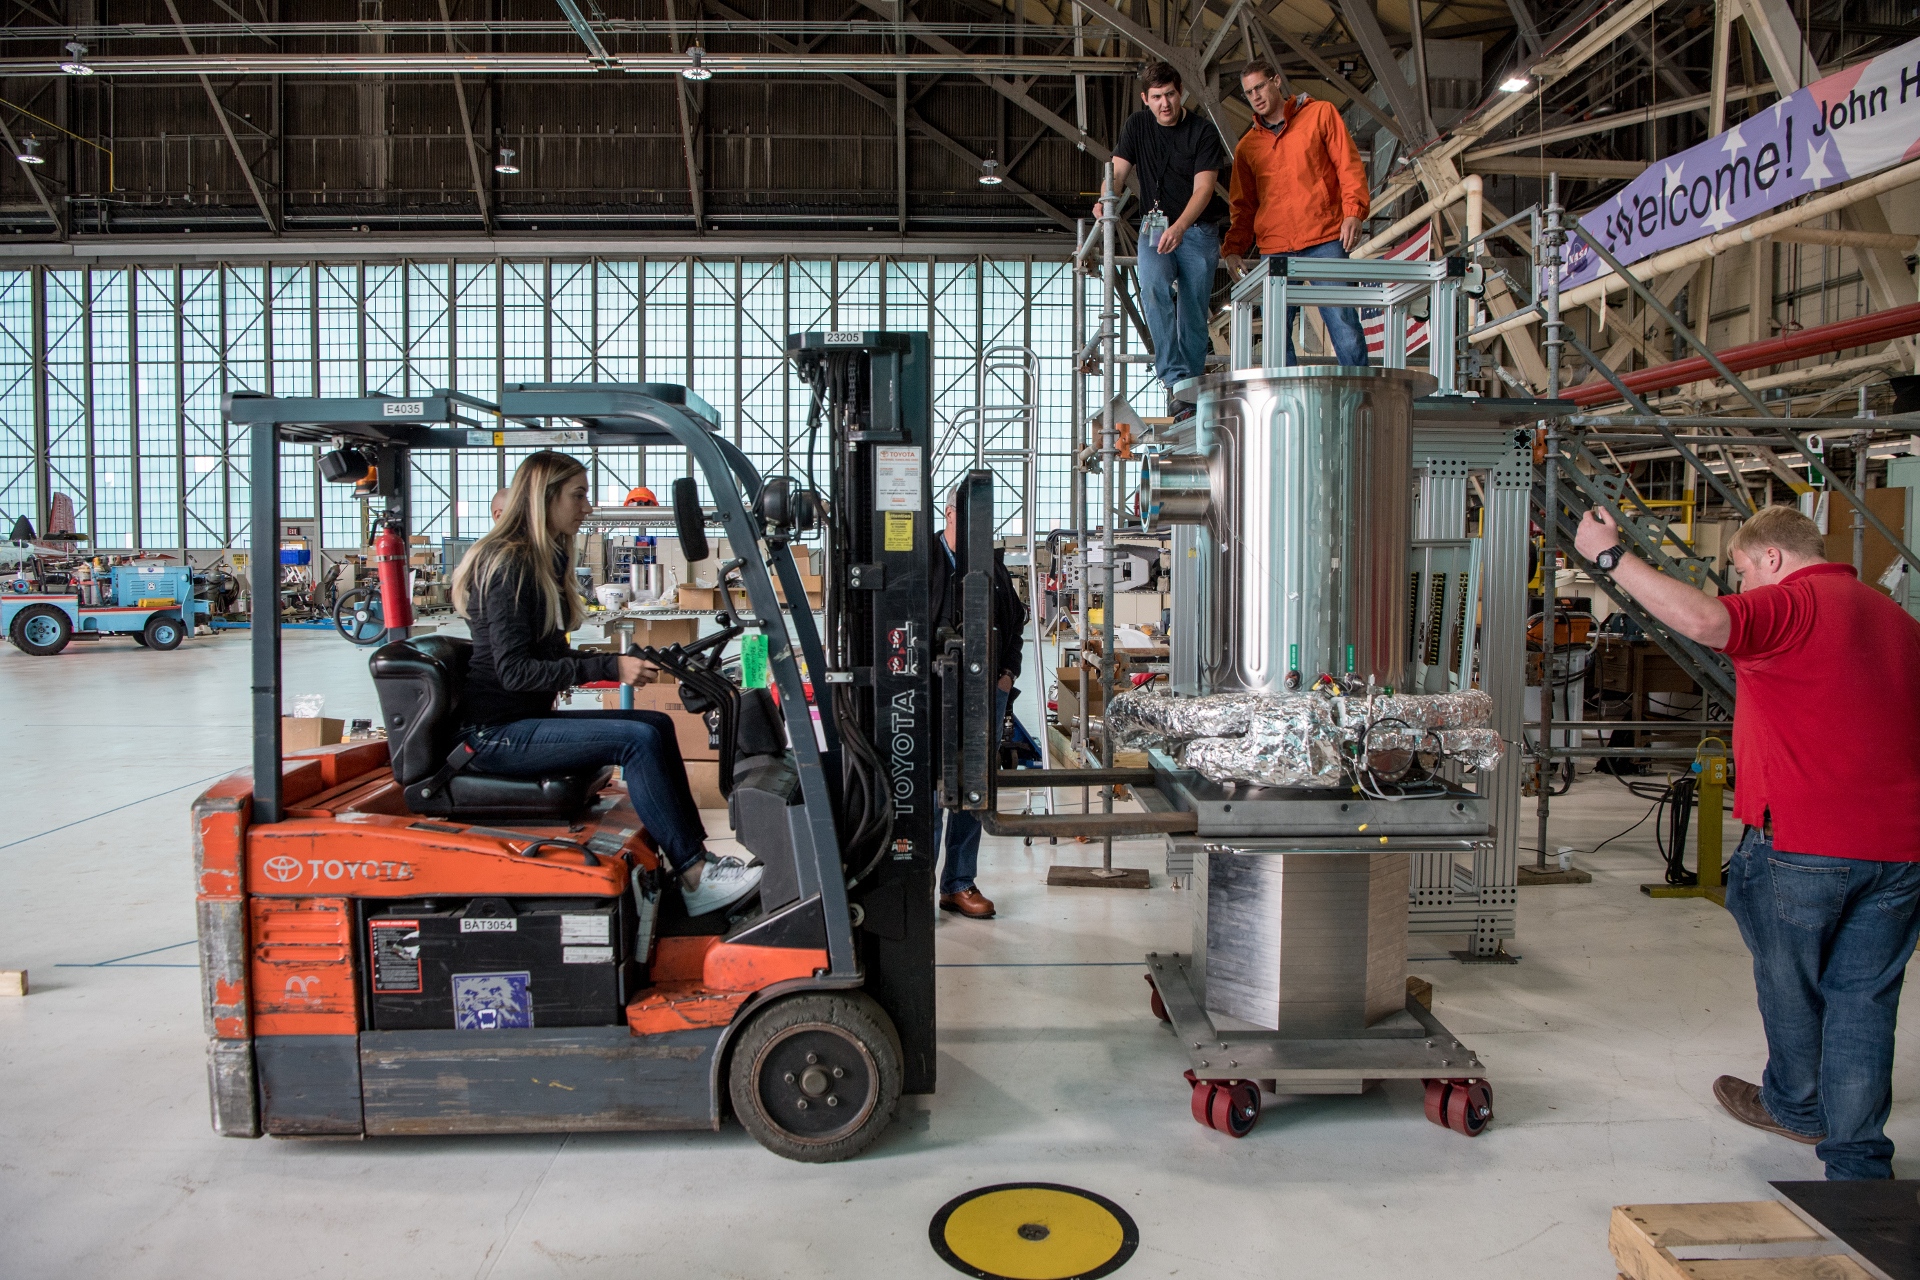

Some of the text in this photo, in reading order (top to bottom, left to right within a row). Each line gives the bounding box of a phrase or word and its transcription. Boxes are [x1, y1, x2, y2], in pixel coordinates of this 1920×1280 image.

[1812, 85, 1887, 136] John
[1605, 115, 1793, 252] Welcome!
[827, 333, 859, 342] 23205
[387, 404, 420, 414] E4035
[892, 689, 915, 819] TOYOTA
[307, 859, 414, 880] TOYOTA
[464, 920, 513, 930] BAT3054
